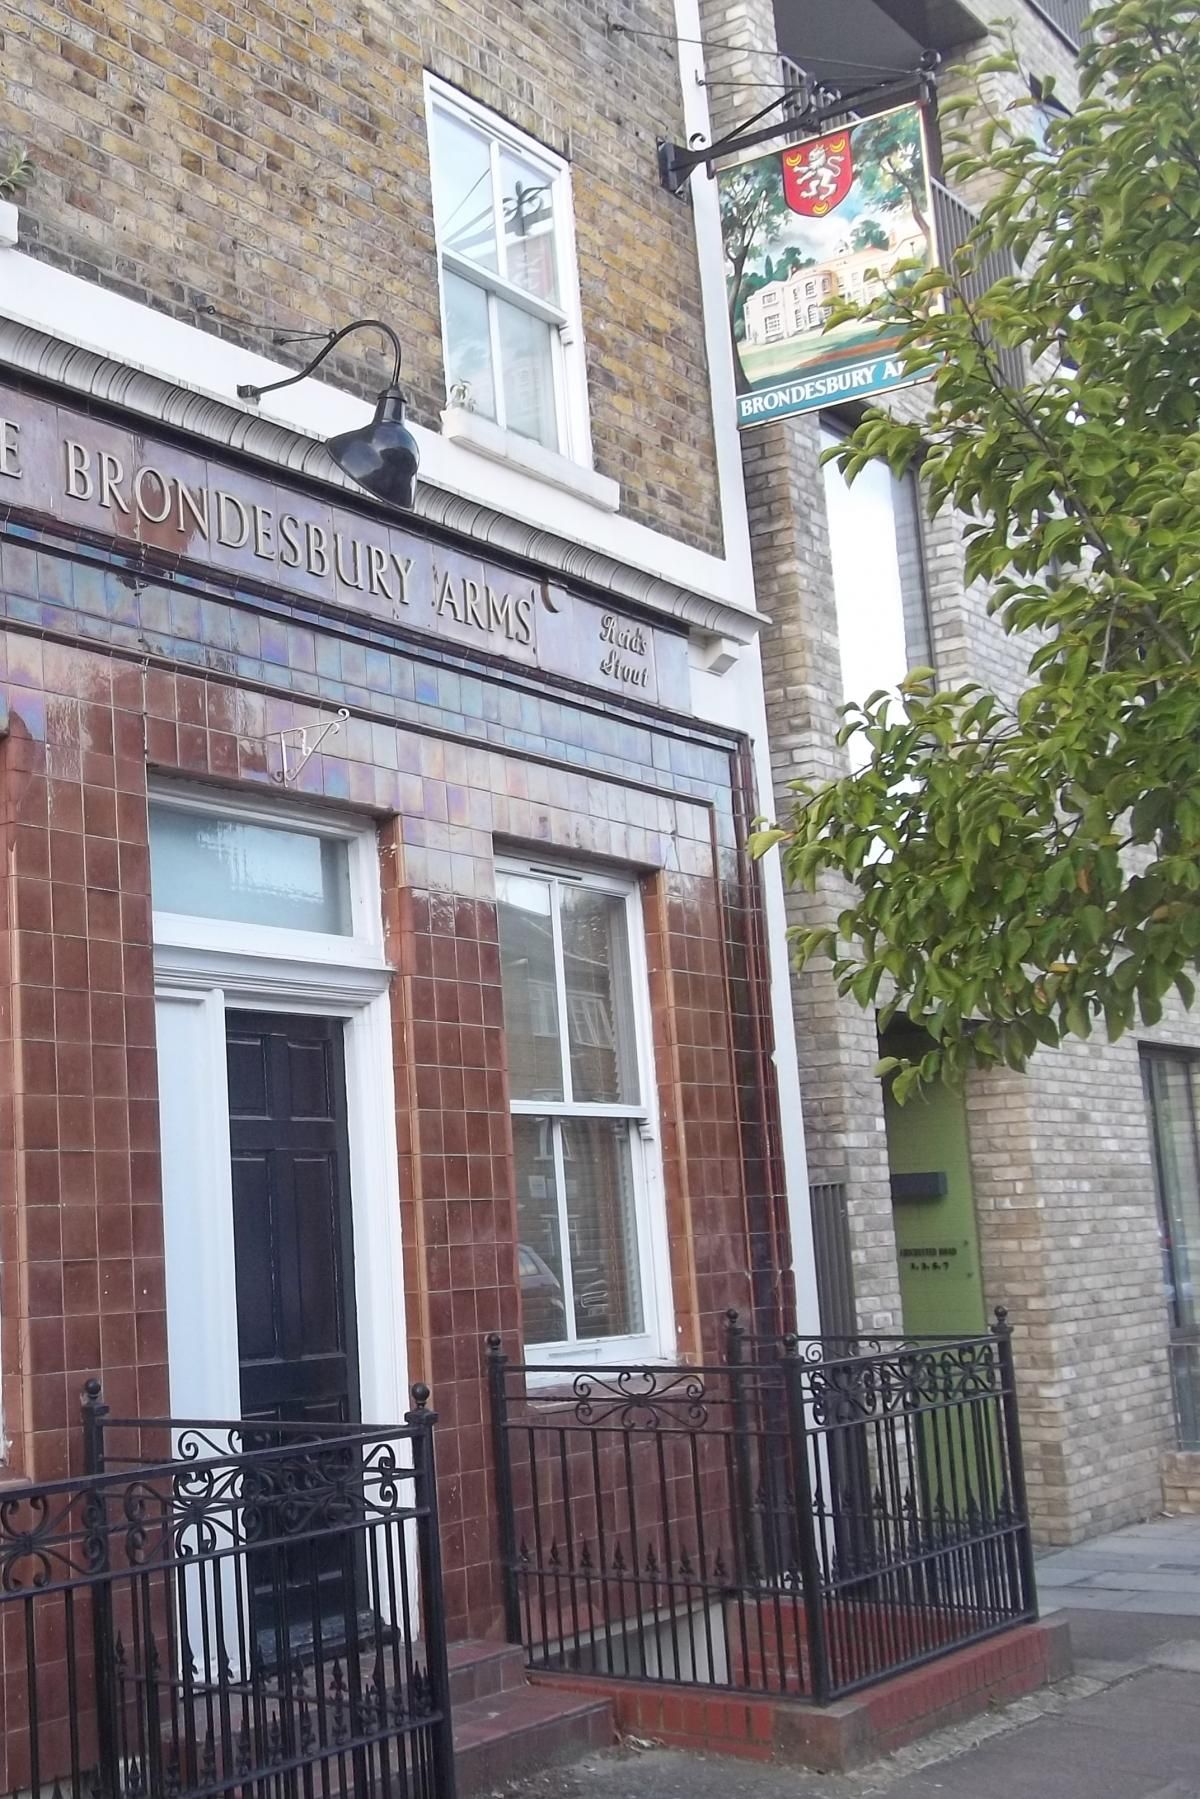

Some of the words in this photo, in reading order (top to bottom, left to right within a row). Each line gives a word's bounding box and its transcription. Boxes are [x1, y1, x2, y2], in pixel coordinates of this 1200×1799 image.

[740, 363, 878, 417] BRONDESBURY
[63, 439, 417, 606] BRONDESBURY
[436, 570, 532, 646] ARMS
[599, 649, 649, 688] Stout
